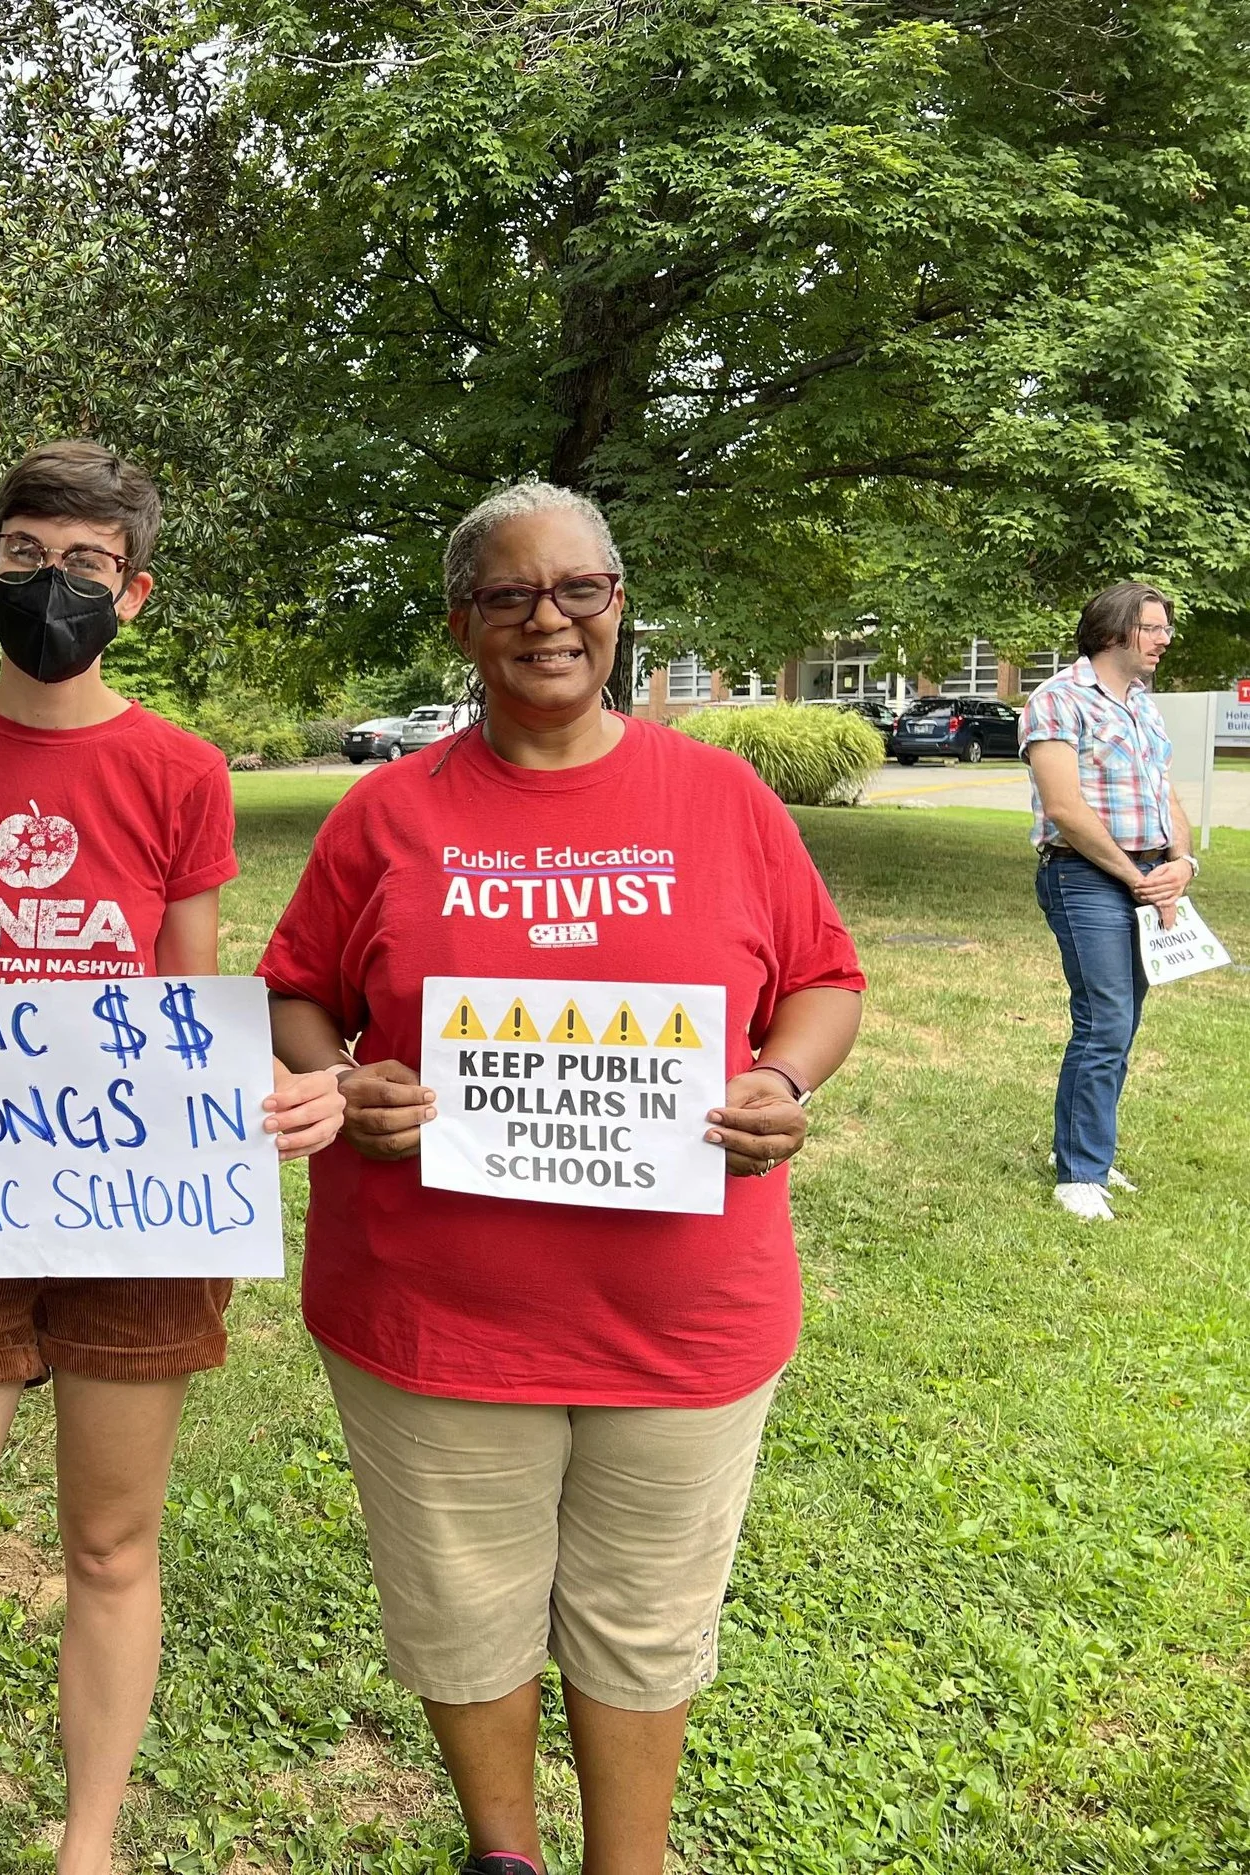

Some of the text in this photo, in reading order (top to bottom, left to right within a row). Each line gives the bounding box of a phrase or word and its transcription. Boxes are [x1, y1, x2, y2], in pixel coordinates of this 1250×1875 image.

[443, 844, 674, 870] Public Education
[441, 875, 676, 919] ACTIVIST
[549, 925, 592, 941] TEA
[1149, 929, 1197, 951] FUNDING
[46, 959, 145, 976] NASHVIL
[1164, 949, 1194, 965] FAIR
[458, 1050, 683, 1085] KEEP PUBLIC
[187, 1088, 246, 1148] IN
[464, 1085, 676, 1119] DOLLARS IN
[507, 1121, 632, 1153] PUBLIC
[485, 1154, 656, 1189] SCHOOLS
[53, 1163, 255, 1234] SCHOOLS
